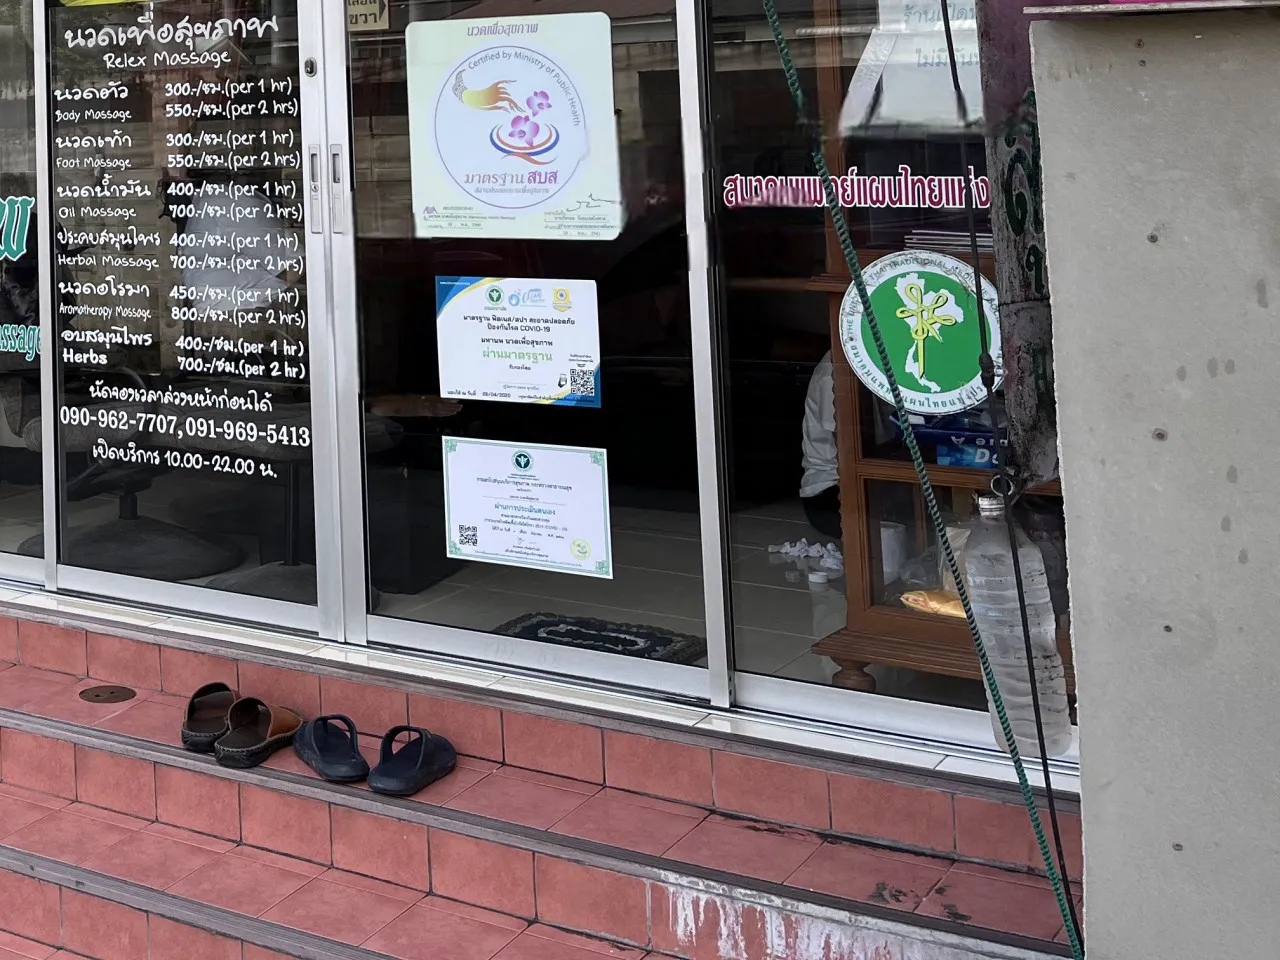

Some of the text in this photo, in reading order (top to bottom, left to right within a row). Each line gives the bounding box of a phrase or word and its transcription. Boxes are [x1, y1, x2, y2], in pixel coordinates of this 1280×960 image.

[64, 2, 279, 51] นวดเพื่อสุขภาพ
[348, 11, 378, 25] ขวา
[467, 21, 539, 37] นวดเพื่อสุขภาพ
[103, 50, 232, 70] Relex Massage
[54, 80, 129, 101] นวดตัว
[271, 77, 292, 95] hr)
[467, 50, 581, 127] Certified by Ministry of Public Health
[55, 108, 80, 123] Body
[84, 109, 132, 122] Massage
[258, 99, 268, 114] 2
[274, 98, 299, 117] hrs)
[55, 130, 132, 148] นวดเท้า
[272, 129, 294, 147] hr)
[56, 158, 81, 168] Foot
[84, 157, 132, 170] Massage
[260, 152, 271, 166] 2
[274, 150, 301, 169] hrs)
[56, 173, 151, 197] นวดน้ำมัน
[275, 180, 296, 200] hr)
[464, 170, 559, 186] มาตรฐาน สบส
[59, 207, 76, 218] Oil
[81, 206, 137, 221] Massage
[263, 203, 275, 218] 2
[276, 202, 303, 222] hrs)
[57, 226, 161, 251] ประคบสมุนไพร
[277, 232, 299, 251] hr)
[58, 253, 97, 266] Herbal
[102, 254, 160, 271] Massage
[264, 257, 275, 271] 2
[276, 256, 304, 275] hrs)
[58, 275, 150, 297] นวดอโรมา
[277, 288, 300, 306] hr)
[59, 301, 113, 319] Aromatherapy
[115, 305, 152, 320] Massage
[267, 310, 277, 324] 2
[280, 310, 306, 329] hrs)
[61, 326, 153, 349] อบสมุนไพร
[283, 340, 305, 357] hr)
[63, 347, 108, 365] Herbs
[270, 362, 282, 376] 2
[284, 361, 306, 379] hr)
[482, 347, 553, 364] ผ่านมาตรฐาน
[89, 380, 273, 413] นัดจองเวลาล่วงหน้าก่อนได้
[92, 438, 278, 478] เปิดบริการ 10.00-22.00 น.
